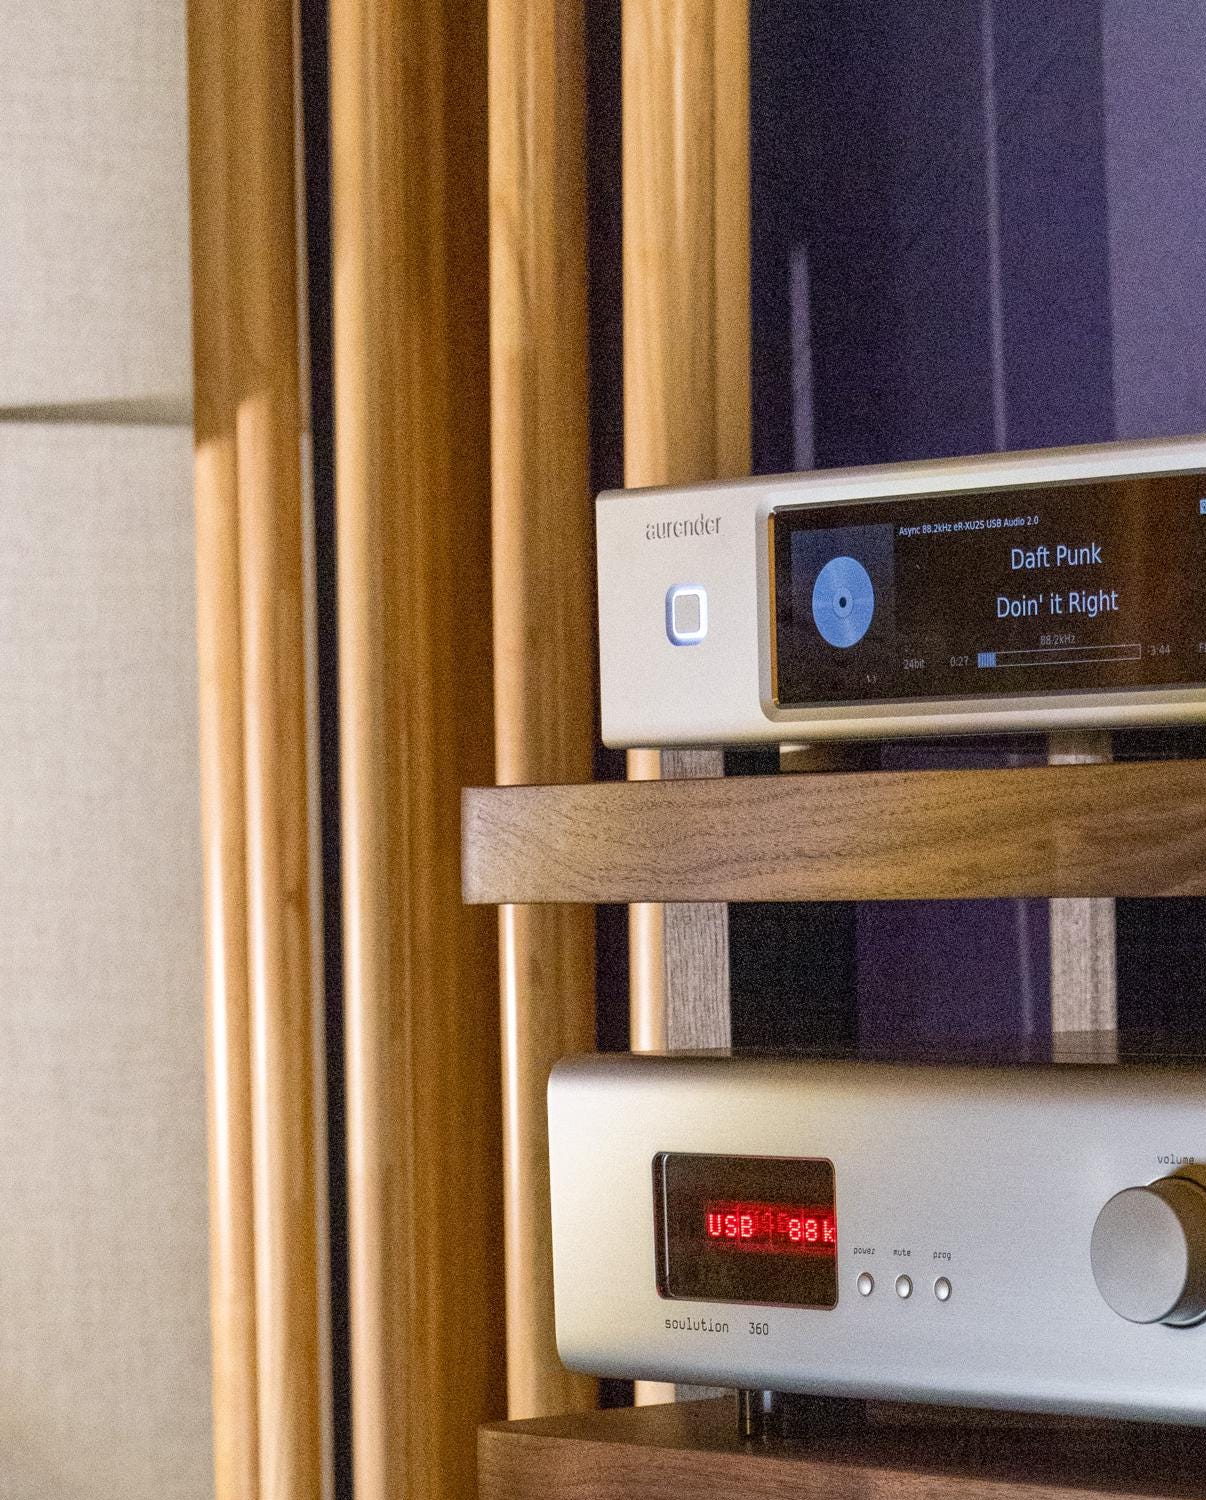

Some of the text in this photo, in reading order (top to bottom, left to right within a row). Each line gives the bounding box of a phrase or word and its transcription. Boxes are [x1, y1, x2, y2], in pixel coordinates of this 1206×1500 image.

[645, 513, 721, 540] aurender
[899, 515, 1039, 537] Async 88.2kHz eR-XU2S USB Audio 2.0
[1011, 542, 1102, 570] Daft Punk
[996, 589, 1119, 618] Doin' it Right
[1040, 634, 1075, 645] 88.2kHz
[1157, 1153, 1195, 1165] volume
[708, 1213, 753, 1239] USB
[854, 1246, 876, 1257] power
[893, 1248, 911, 1257] mute
[933, 1250, 951, 1261] prog
[664, 1317, 769, 1336] soulution 360
